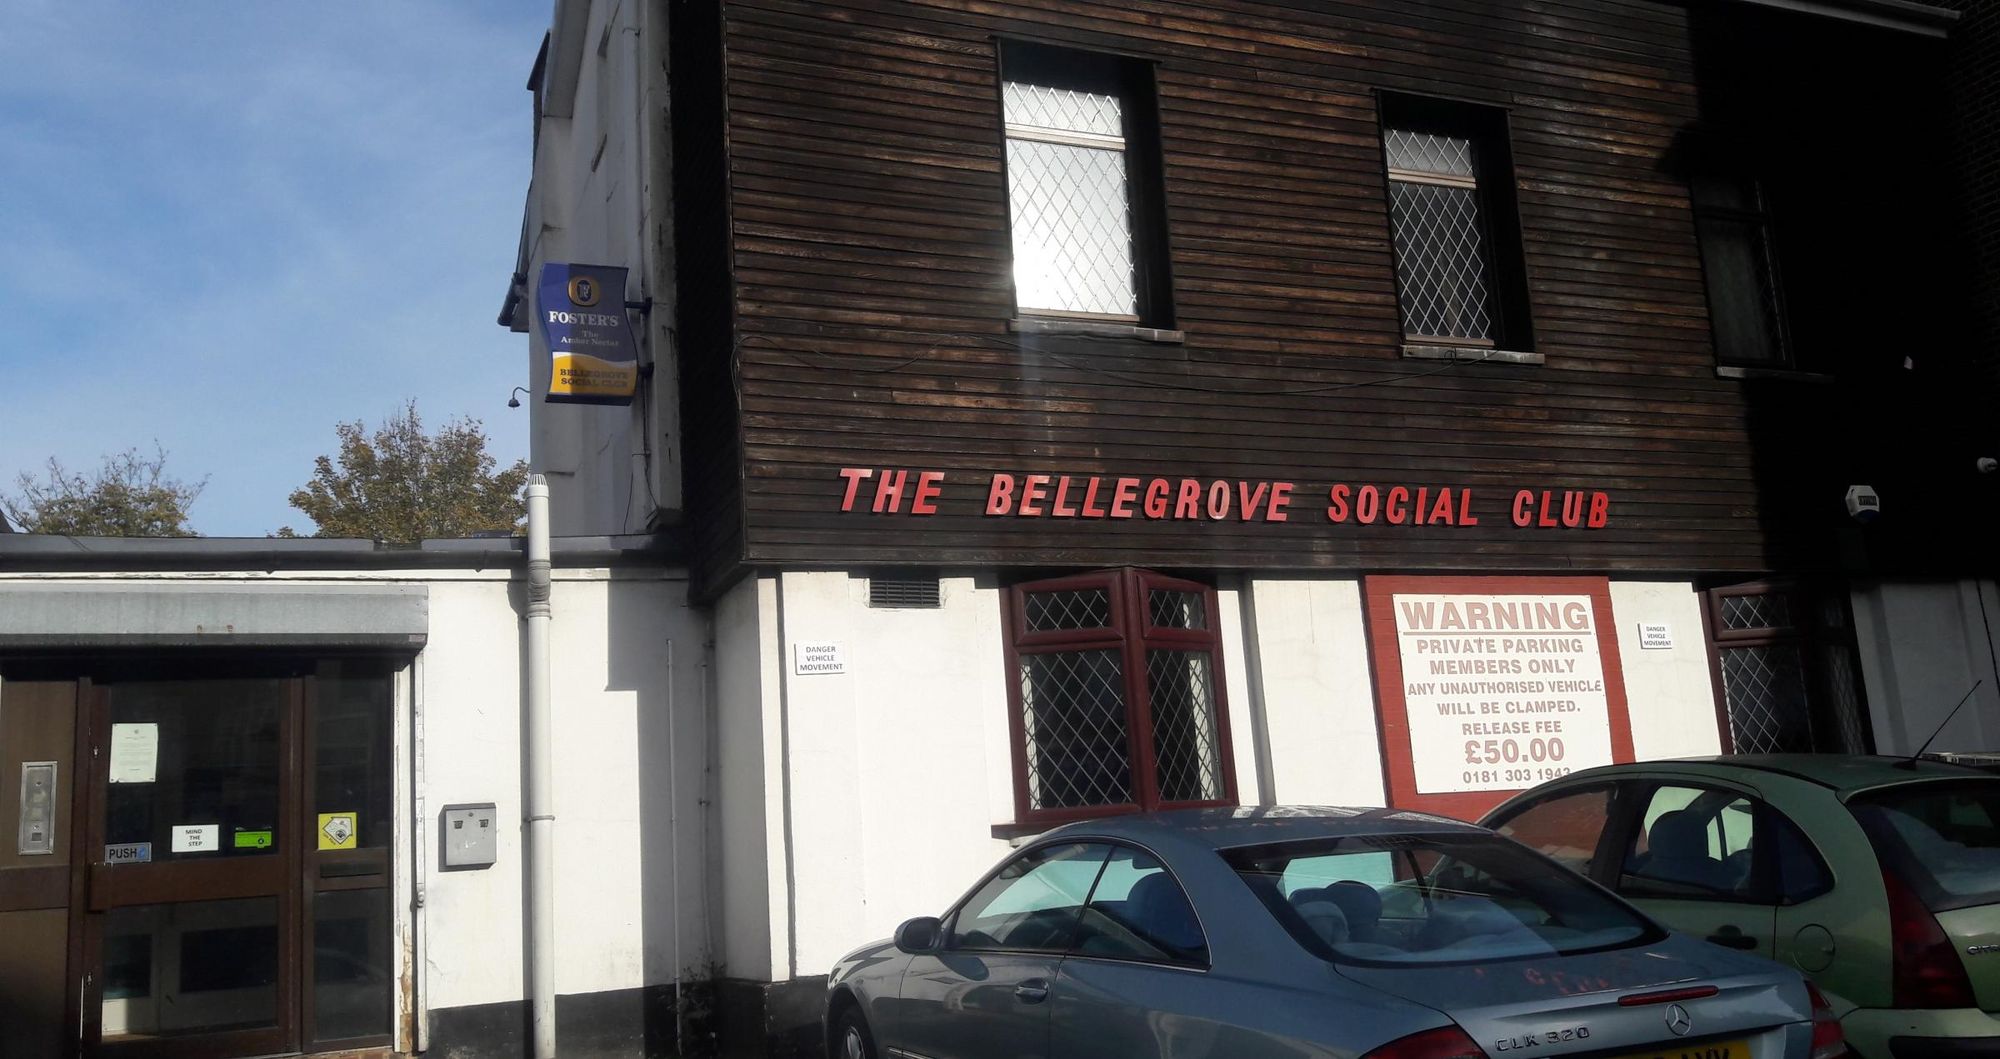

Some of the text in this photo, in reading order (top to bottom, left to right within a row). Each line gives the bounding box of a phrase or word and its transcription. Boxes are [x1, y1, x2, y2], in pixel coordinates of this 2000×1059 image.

[548, 311, 619, 327] FOSTER'S
[839, 468, 1610, 529] THE BELLEGROVE SOCIAL CLUB
[1400, 601, 1590, 631] WARNING
[805, 645, 836, 653] DANGER
[1416, 638, 1584, 654] PRIVATE PARKING
[806, 654, 834, 662] VEHICLE
[799, 663, 843, 671] MOVEMENT
[1429, 658, 1576, 675] MEMBERS ONLY
[1408, 679, 1602, 696] ANY UNAUTHORISED VEHICLE
[1436, 700, 1581, 716] WILL BE CLAMPED.
[1461, 720, 1563, 736] RELEASE FEE
[1464, 737, 1565, 765] £50.00
[1462, 770, 1499, 784] 0181
[1505, 768, 1531, 782] 303
[109, 848, 137, 859] PUSH
[1495, 1026, 1590, 1052] CLK 320
